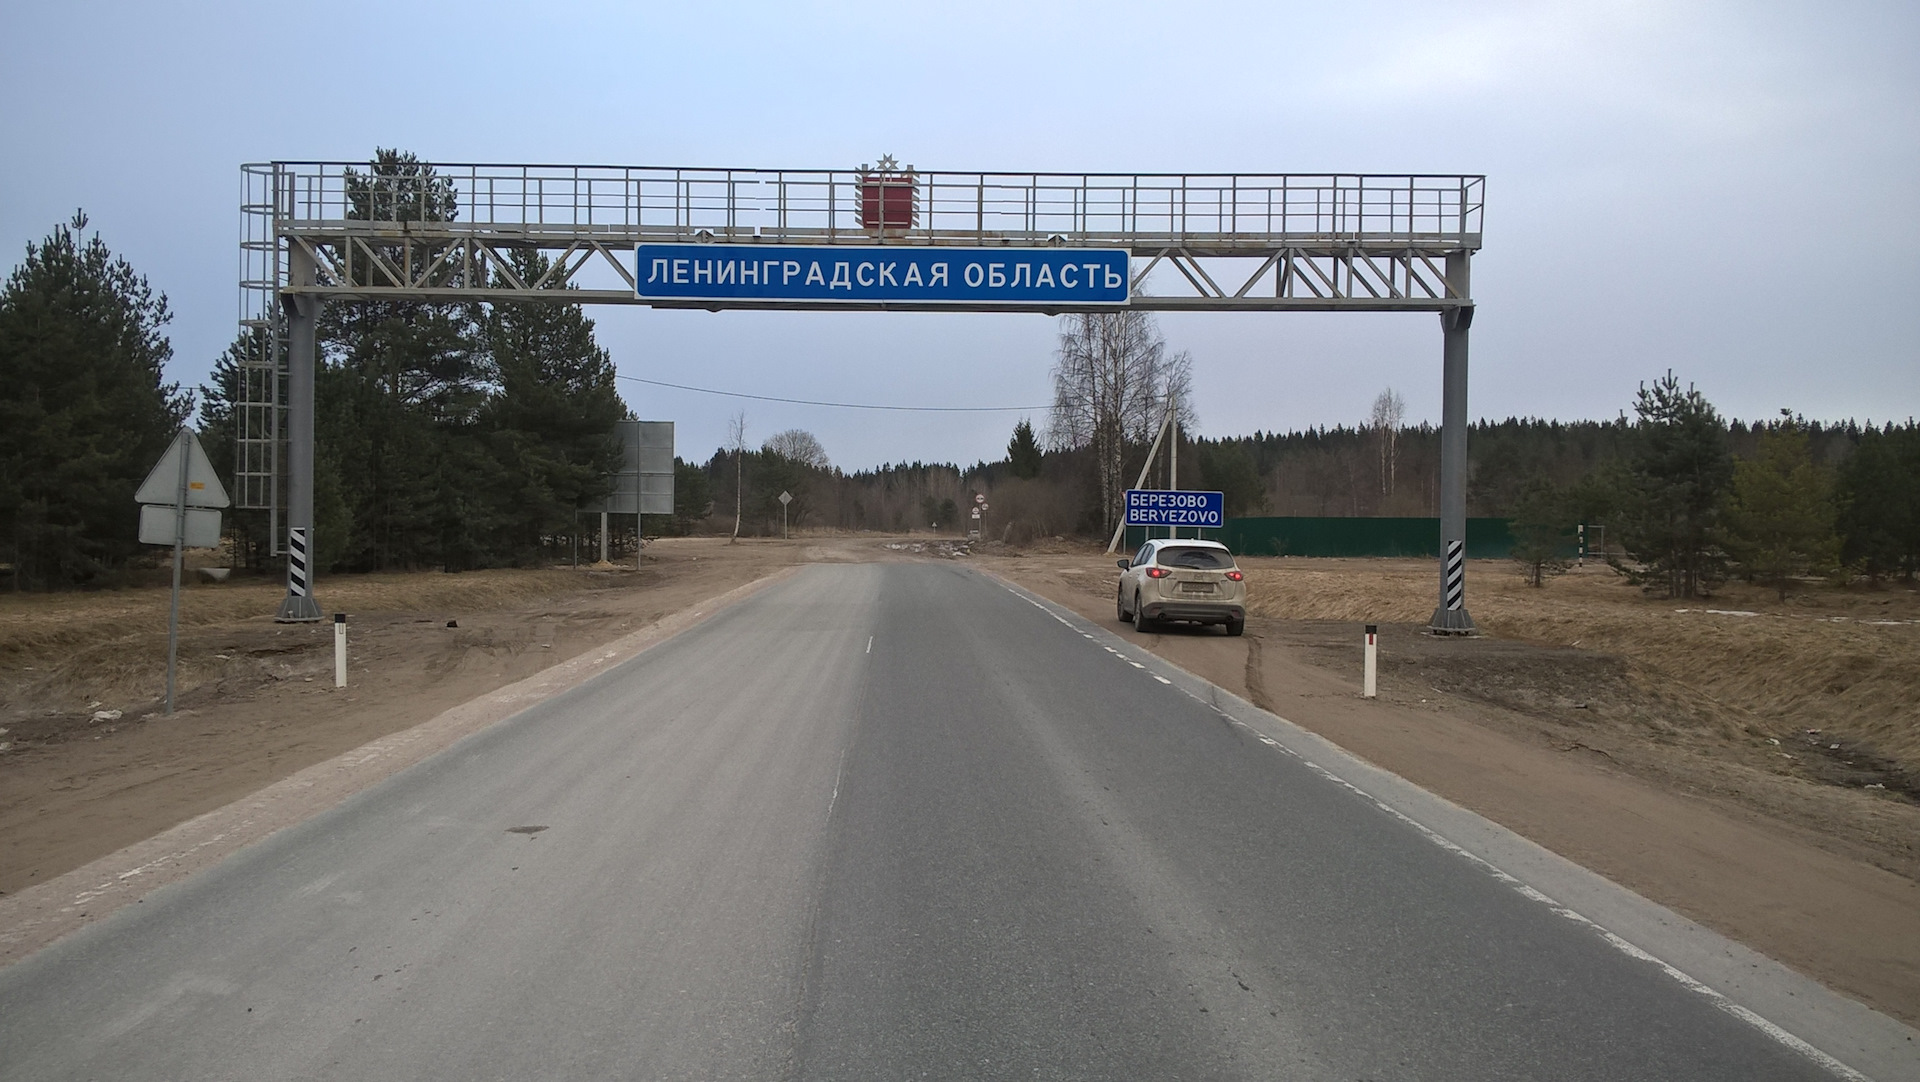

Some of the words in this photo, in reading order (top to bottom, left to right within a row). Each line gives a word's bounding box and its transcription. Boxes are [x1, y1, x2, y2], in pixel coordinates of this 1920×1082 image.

[647, 259, 948, 290] ЛЕНИНГРАДСКАЯ
[964, 262, 1122, 289] ОБЛАСТЬ
[1130, 494, 1207, 508] БЕРЕЗОВО
[1130, 509, 1218, 523] BERYEZOVO
